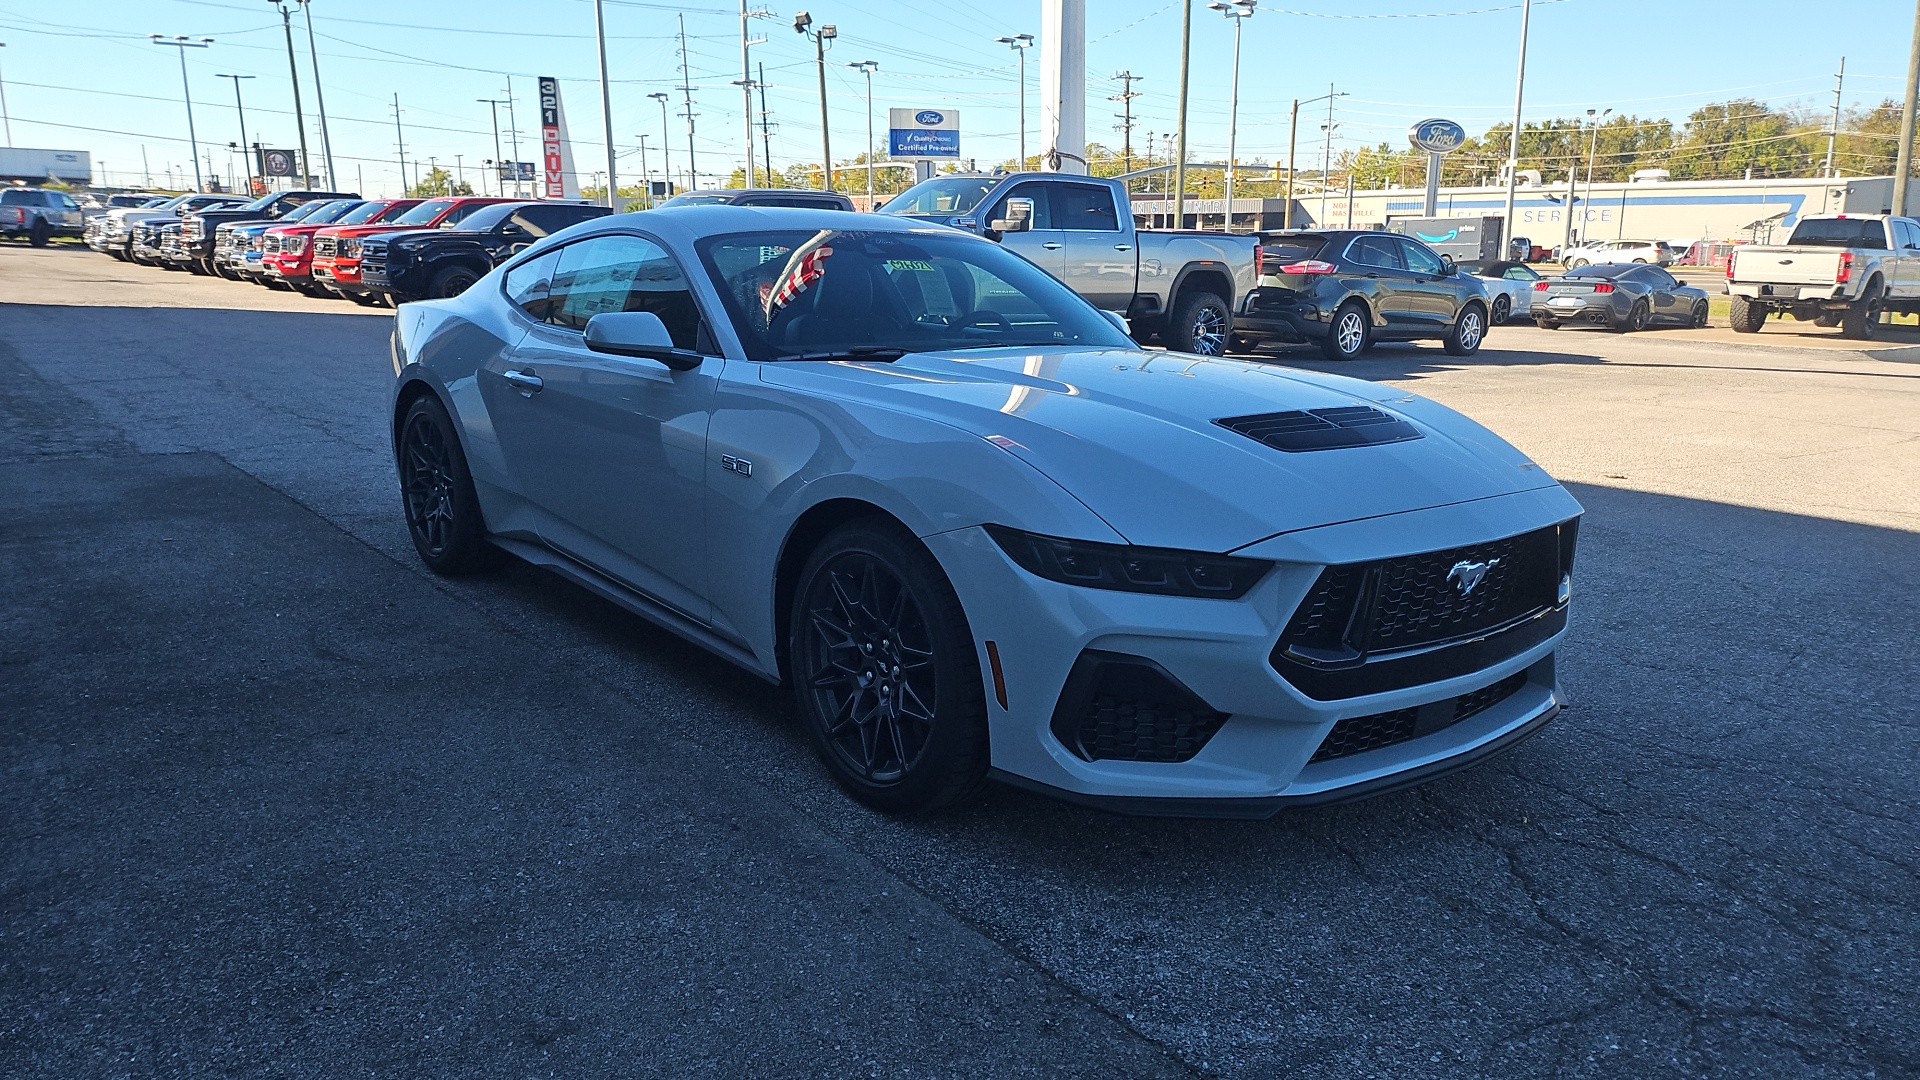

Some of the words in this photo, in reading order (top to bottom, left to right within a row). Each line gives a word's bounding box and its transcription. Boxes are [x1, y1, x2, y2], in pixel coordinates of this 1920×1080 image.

[541, 81, 556, 123] 321
[1426, 125, 1458, 146] Ford
[543, 128, 562, 196] DRIVE
[1151, 201, 1158, 213] &
[1165, 201, 1229, 213] CUNTRY
[1524, 209, 1611, 222] SERICE
[1458, 224, 1476, 233] prime
